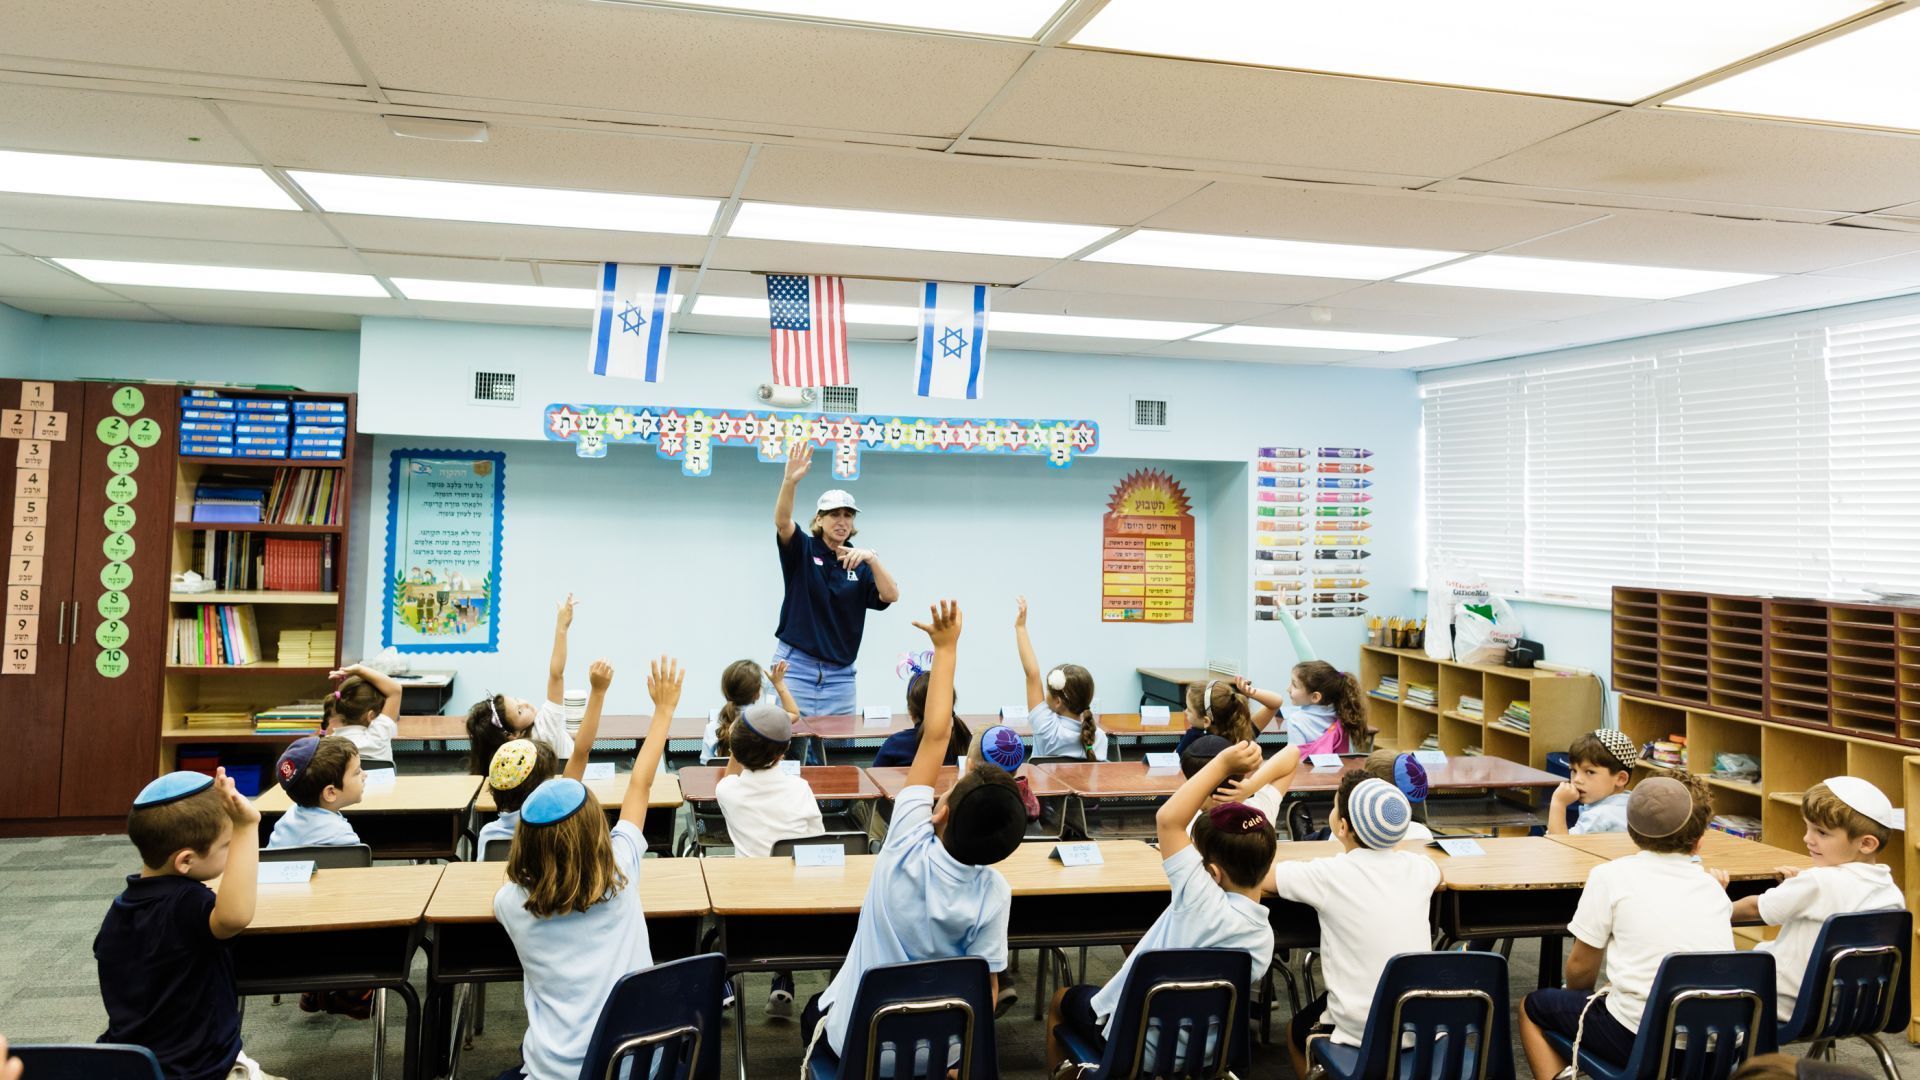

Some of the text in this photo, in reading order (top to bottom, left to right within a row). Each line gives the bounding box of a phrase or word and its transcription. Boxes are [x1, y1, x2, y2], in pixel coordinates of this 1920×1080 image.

[35, 386, 41, 397] 1
[126, 389, 131, 400] 1
[14, 414, 23, 425] 2
[47, 415, 56, 427] 2
[110, 419, 121, 430] 2
[614, 417, 624, 430] ר
[667, 418, 678, 432] צ
[141, 420, 150, 431] 2
[641, 418, 652, 436] ק
[719, 419, 730, 434] ע
[745, 420, 755, 434] ס
[769, 421, 777, 435] נ
[792, 422, 803, 437] מ
[820, 417, 829, 437] ל
[869, 426, 875, 434] י
[891, 426, 901, 441] ט
[915, 428, 926, 441] ח
[941, 429, 947, 443] ז
[964, 429, 971, 443] ו
[986, 430, 996, 443] ה
[1010, 430, 1019, 444] ד
[1033, 430, 1041, 443] ג
[1078, 431, 1088, 445] א
[29, 444, 39, 455] 3
[119, 448, 128, 459] 3
[28, 473, 38, 484] 4
[117, 477, 127, 488] 4
[27, 501, 35, 513] 5
[117, 506, 125, 517] 5
[25, 531, 34, 542] 6
[116, 535, 124, 545] 6
[22, 561, 30, 571] 7
[114, 564, 121, 574] 7
[20, 589, 29, 601] 8
[110, 592, 119, 603] 8
[18, 619, 27, 630] 9
[110, 622, 118, 632] 9
[13, 649, 29, 660] 10
[106, 651, 121, 661] 10
[1242, 814, 1263, 829] Caleb
